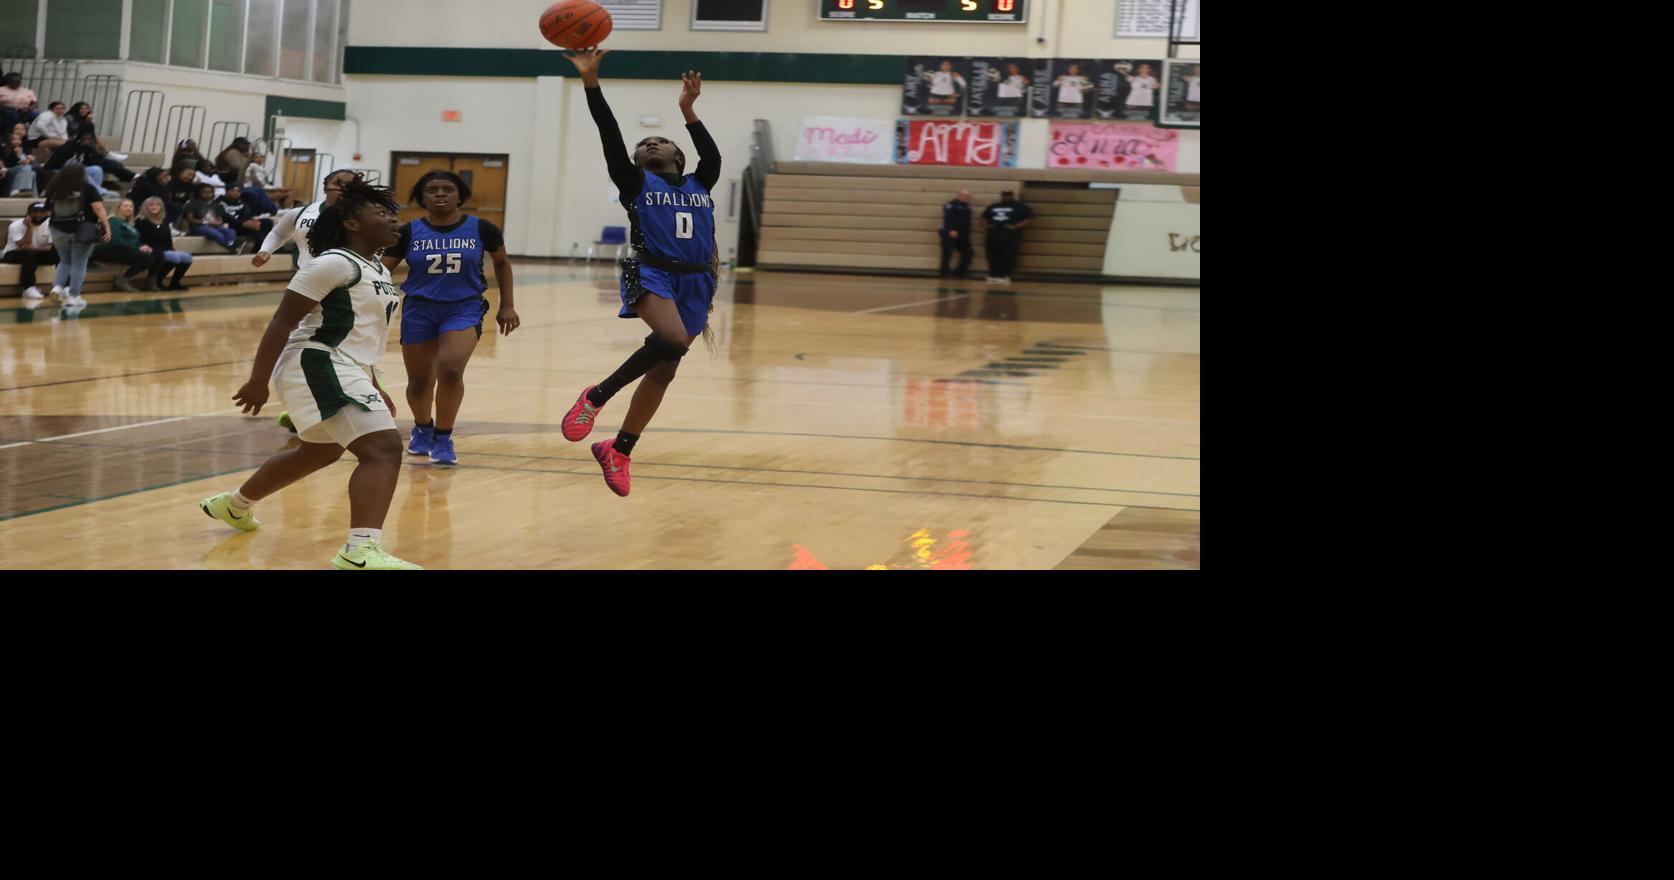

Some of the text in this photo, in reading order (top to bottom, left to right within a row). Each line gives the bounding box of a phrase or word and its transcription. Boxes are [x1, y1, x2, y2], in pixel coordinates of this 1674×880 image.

[675, 211, 694, 239] 0
[413, 238, 476, 251] STALLIONS
[425, 252, 462, 274] 25
